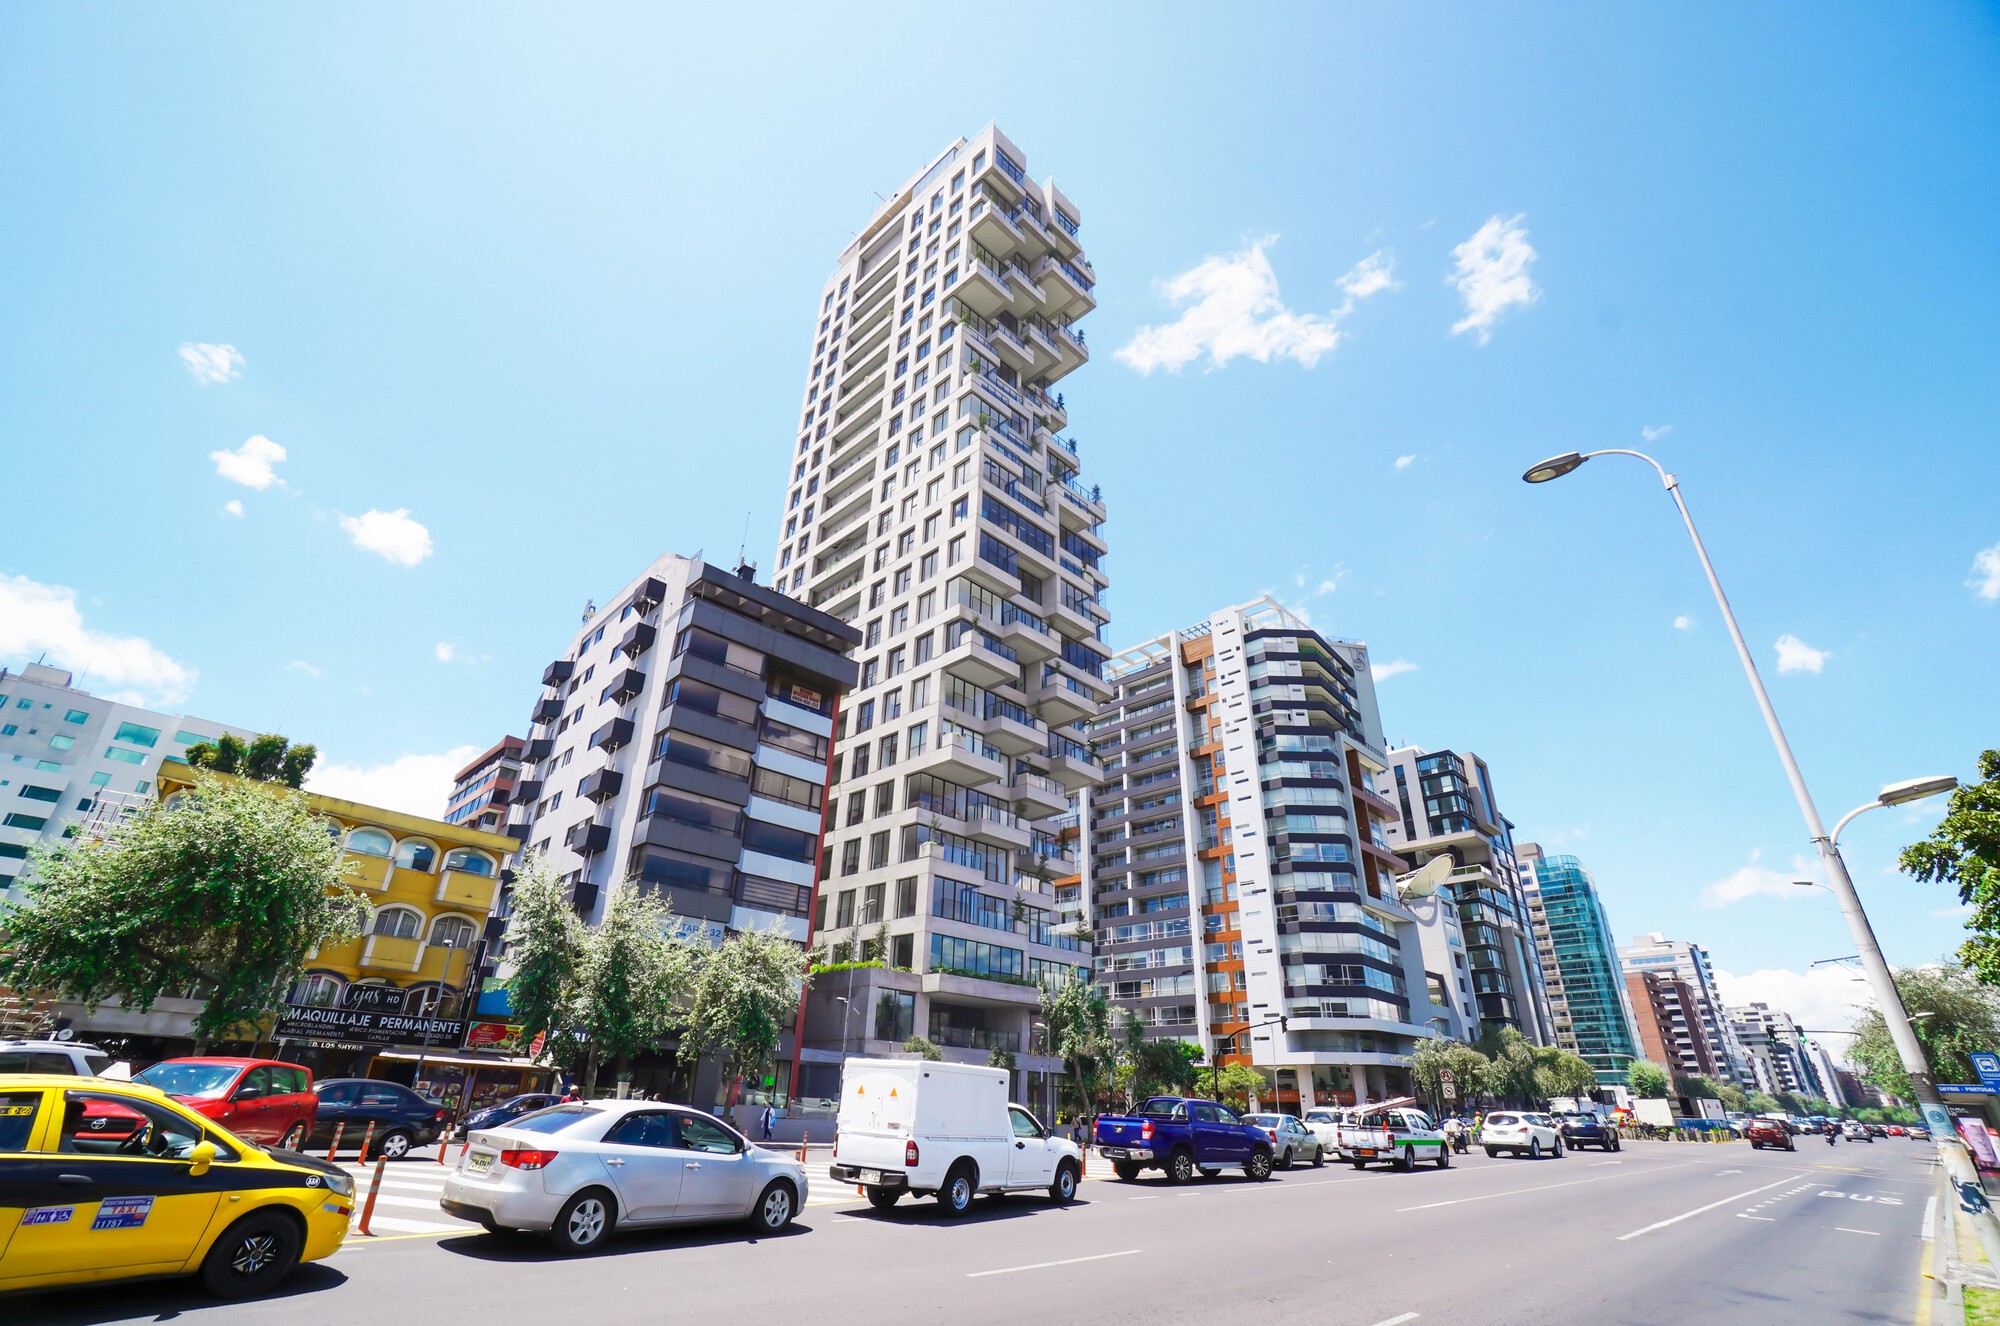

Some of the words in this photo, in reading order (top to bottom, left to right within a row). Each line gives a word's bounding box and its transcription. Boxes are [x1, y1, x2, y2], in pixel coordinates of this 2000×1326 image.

[386, 995, 400, 1004] HD
[287, 1007, 372, 1027] MAQUILLAJE
[380, 1016, 461, 1034] PERMANENTE
[290, 1022, 336, 1030] MICROBLANDING
[305, 1030, 345, 1038] PERMANENTE
[368, 1028, 408, 1036] PIGMENTACION
[337, 1043, 364, 1051] SHYRIS
[1817, 1190, 1904, 1205] BUS
[112, 1205, 139, 1214] TAXI
[95, 1219, 123, 1229] 11757
